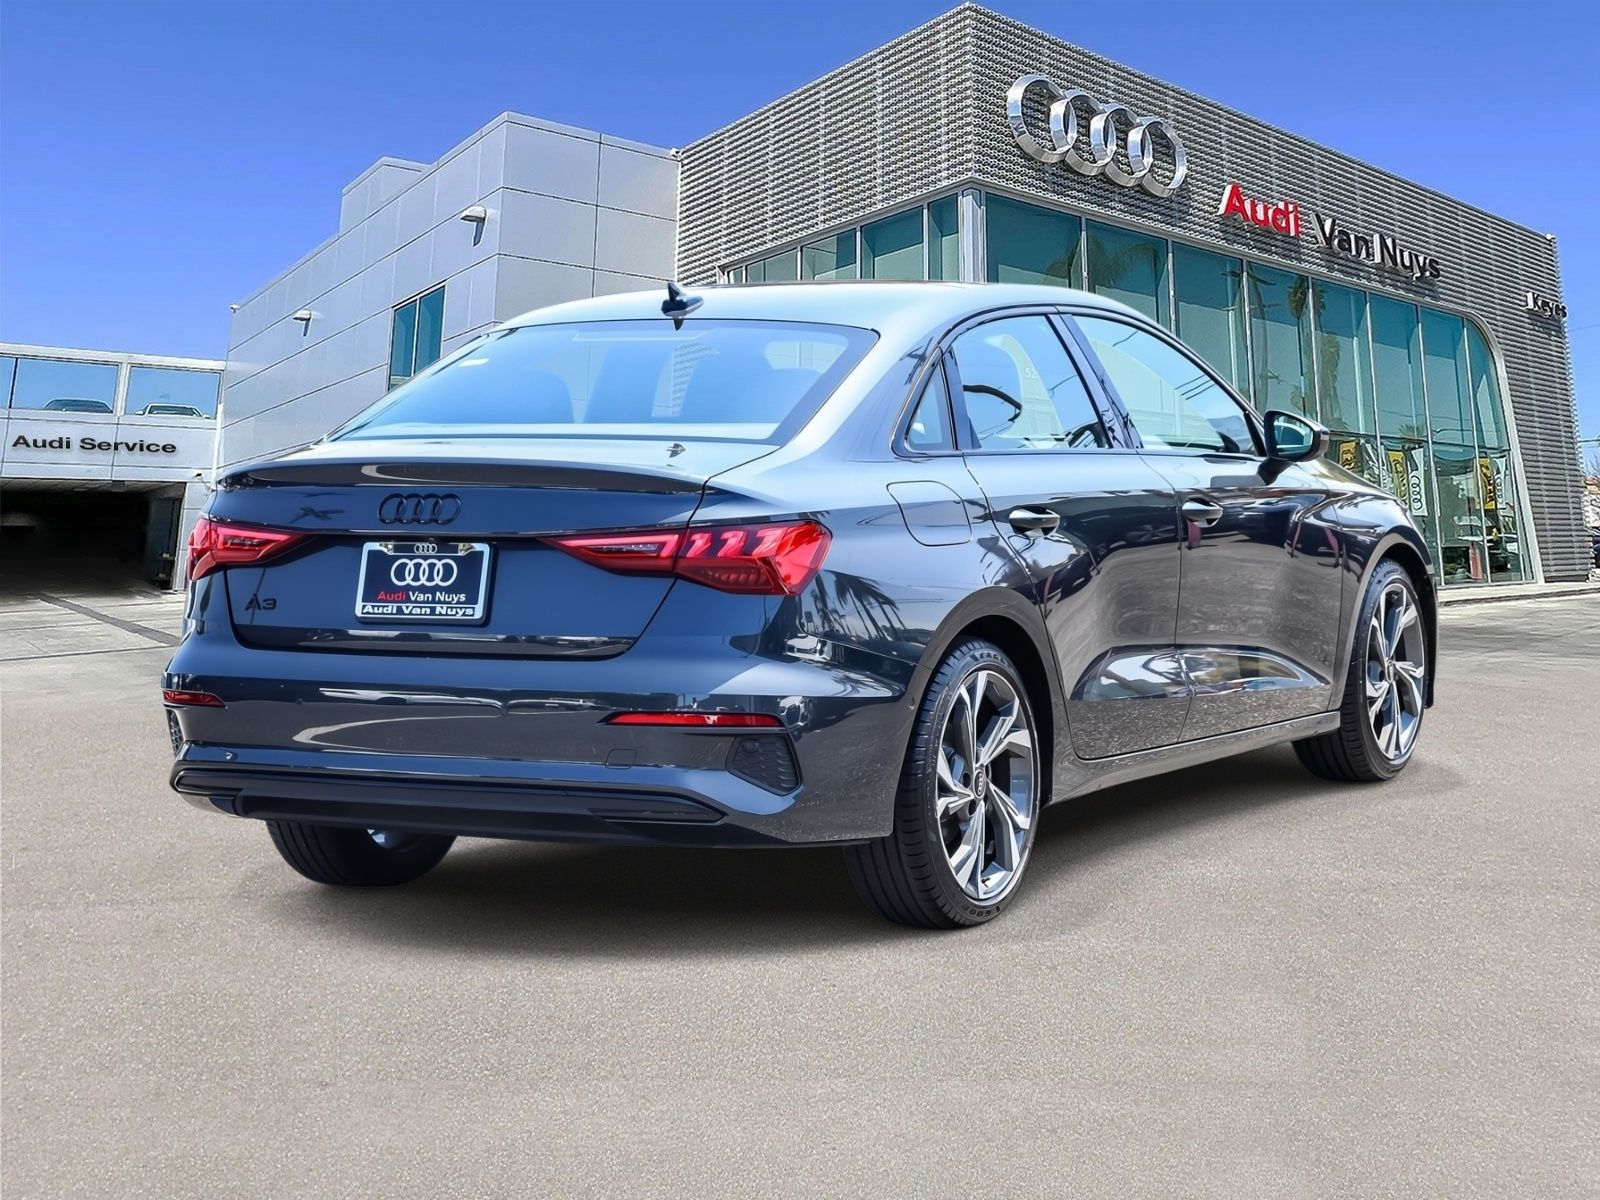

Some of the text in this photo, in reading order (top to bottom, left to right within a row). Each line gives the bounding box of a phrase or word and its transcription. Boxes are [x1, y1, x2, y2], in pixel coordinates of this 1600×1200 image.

[1218, 183, 1441, 280] Audi Van Nuys
[12, 435, 177, 453] Audi Service
[377, 590, 466, 604] Audi Van Nuys
[362, 604, 474, 617] Audi Van Nuys
